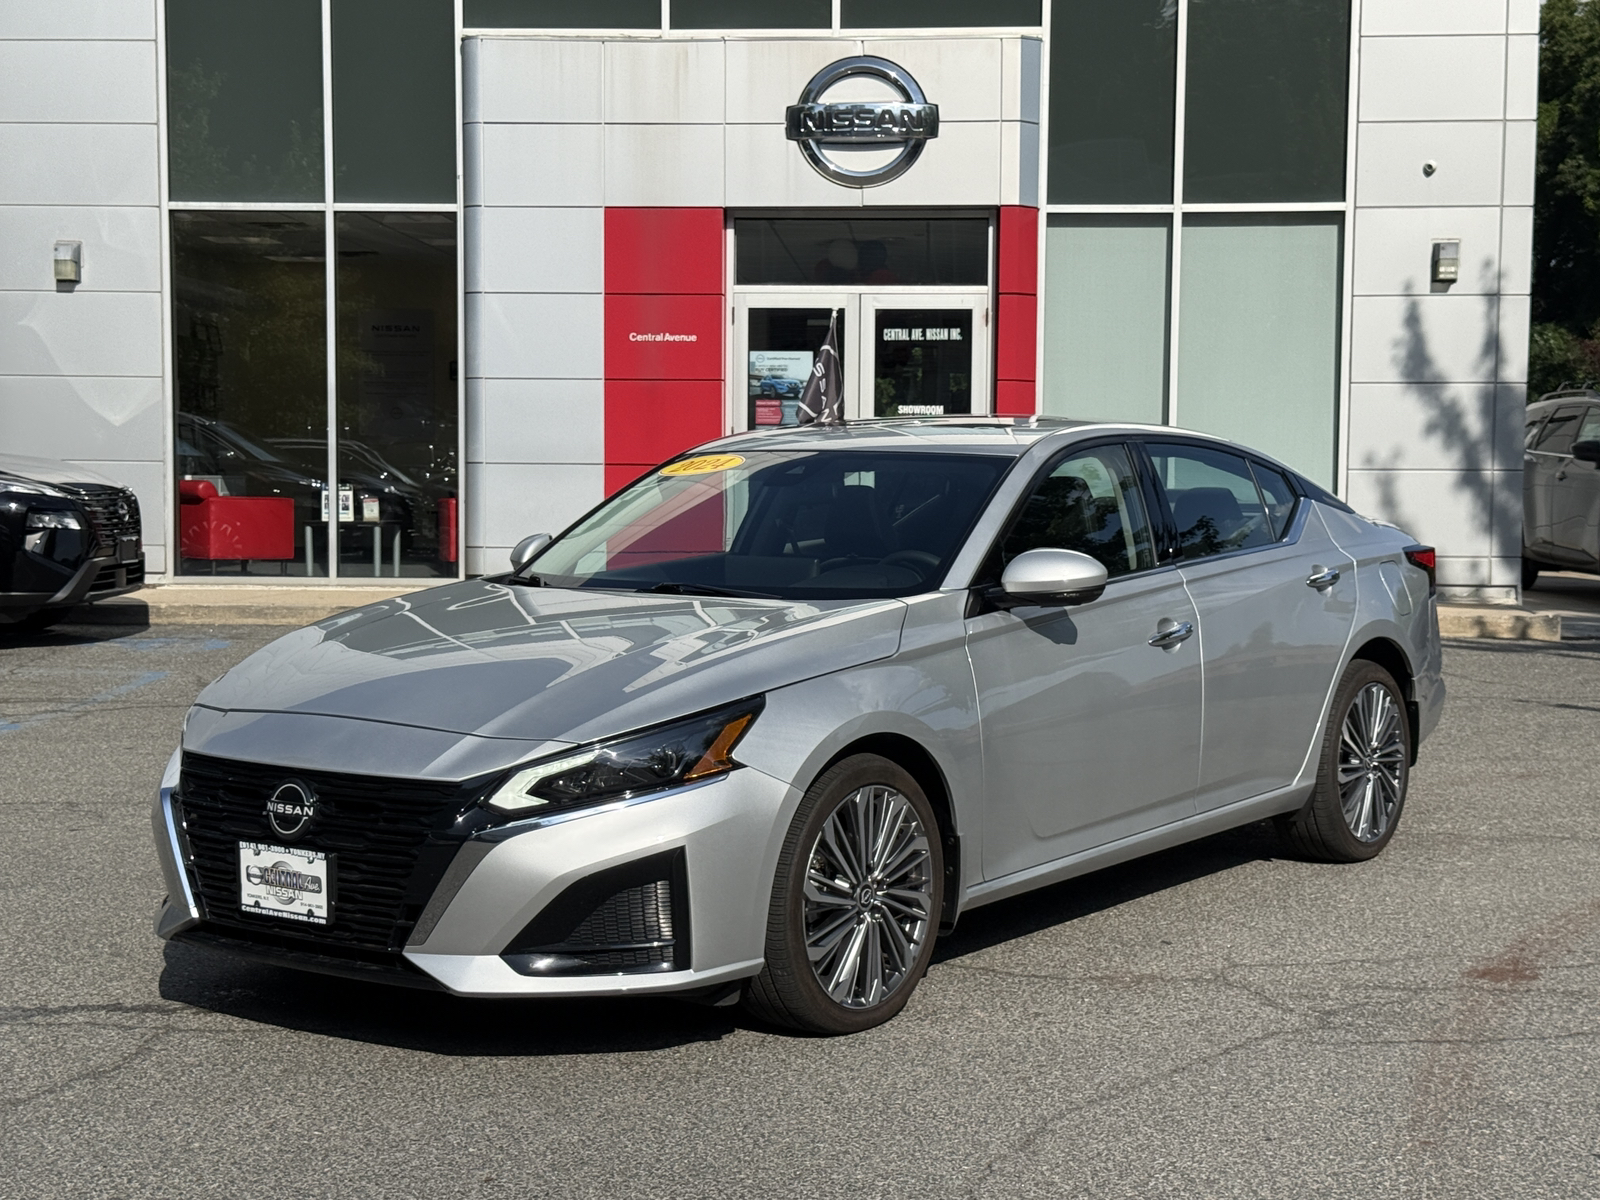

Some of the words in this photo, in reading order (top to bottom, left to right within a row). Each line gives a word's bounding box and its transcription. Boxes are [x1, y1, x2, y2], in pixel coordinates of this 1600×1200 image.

[800, 109, 924, 133] NISSAN
[629, 332, 663, 342] Central
[664, 332, 697, 342] Avenue
[883, 328, 910, 341] CENTRAL
[926, 328, 949, 341] NISSAN
[898, 404, 944, 415] SHOWROOM
[668, 457, 737, 473] 2024
[266, 801, 314, 816] NISSAN
[266, 885, 304, 901] NISSAN
